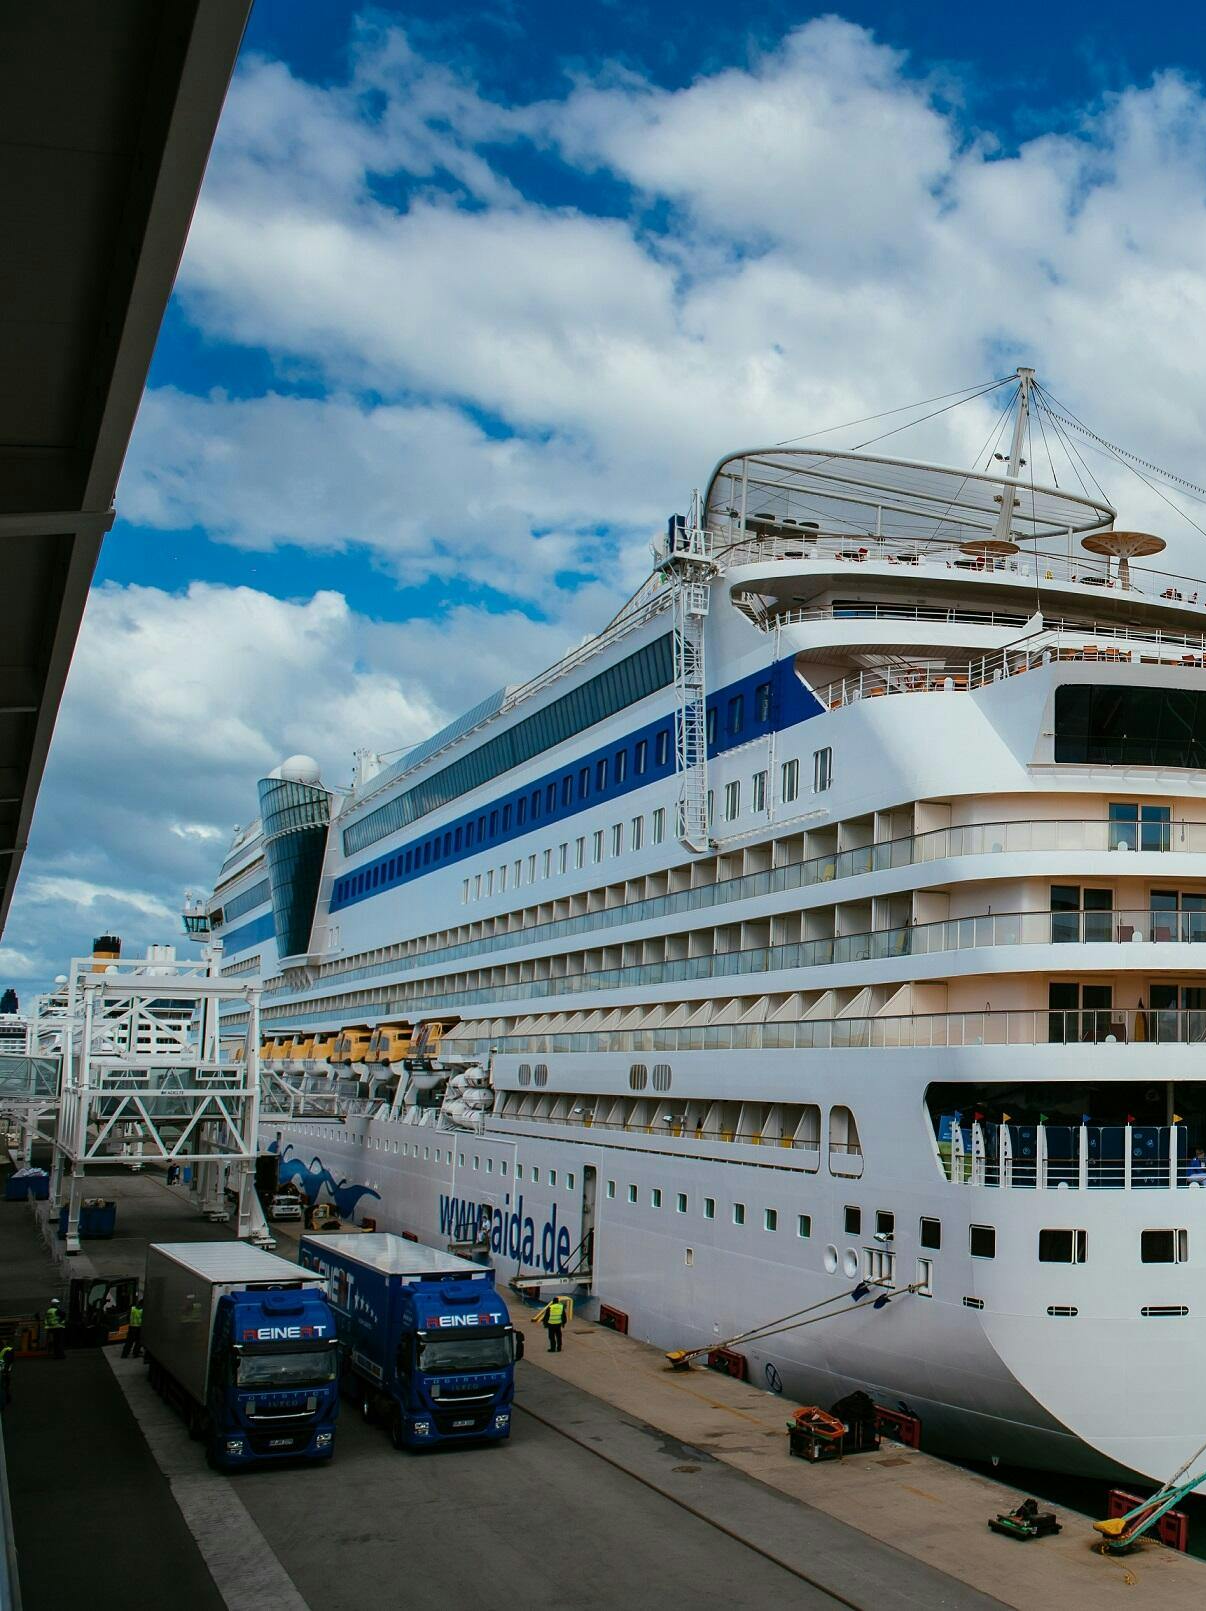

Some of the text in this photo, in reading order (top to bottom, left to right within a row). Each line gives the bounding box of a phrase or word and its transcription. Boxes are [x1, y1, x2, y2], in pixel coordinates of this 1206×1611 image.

[440, 1193, 571, 1274] wwwaida.de
[426, 1313, 501, 1327] REINERT
[243, 1326, 326, 1340] REINERT
